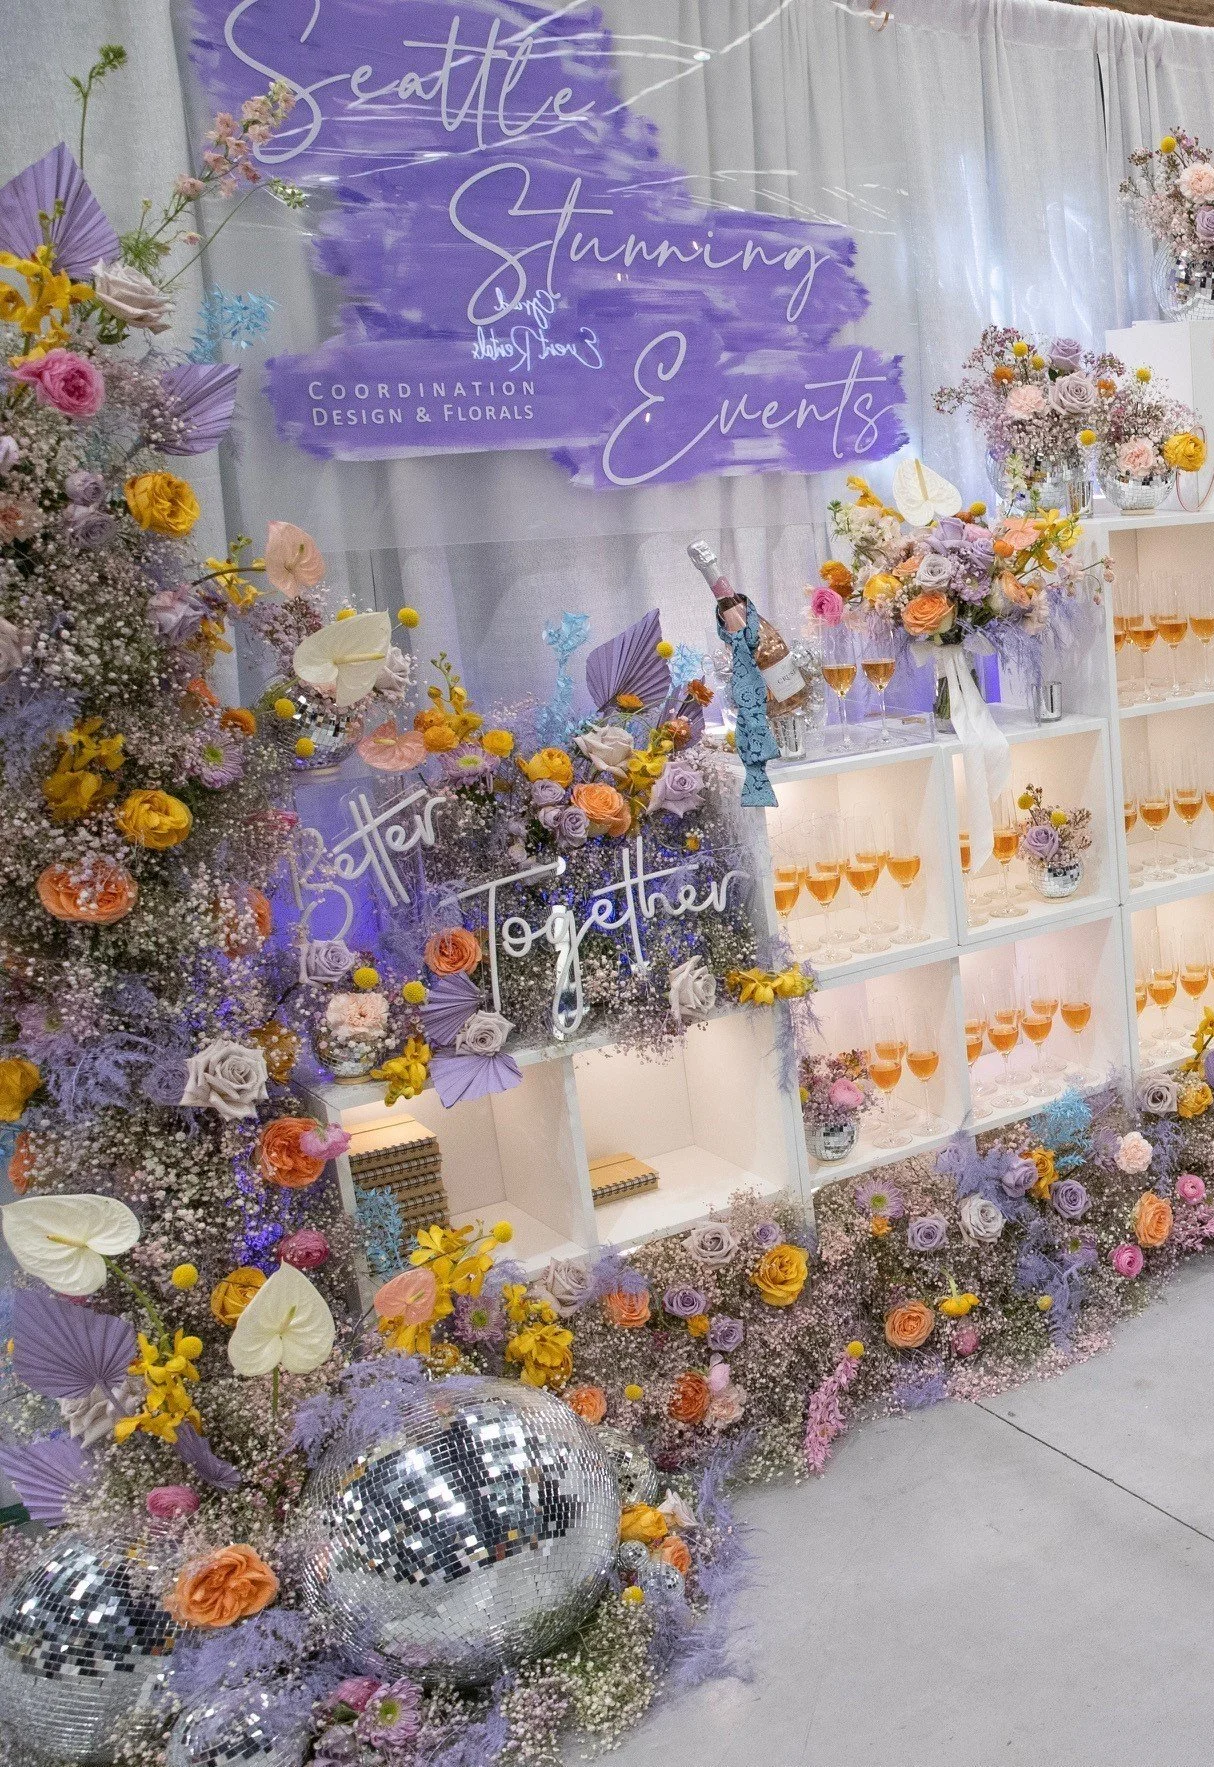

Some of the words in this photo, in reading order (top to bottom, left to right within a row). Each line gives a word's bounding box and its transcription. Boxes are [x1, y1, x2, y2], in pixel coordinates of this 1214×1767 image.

[225, 0, 595, 164] Seattle
[450, 162, 829, 326] Stunning
[416, 404, 432, 425] &
[602, 331, 895, 486] Events
[456, 835, 754, 1033] Together
